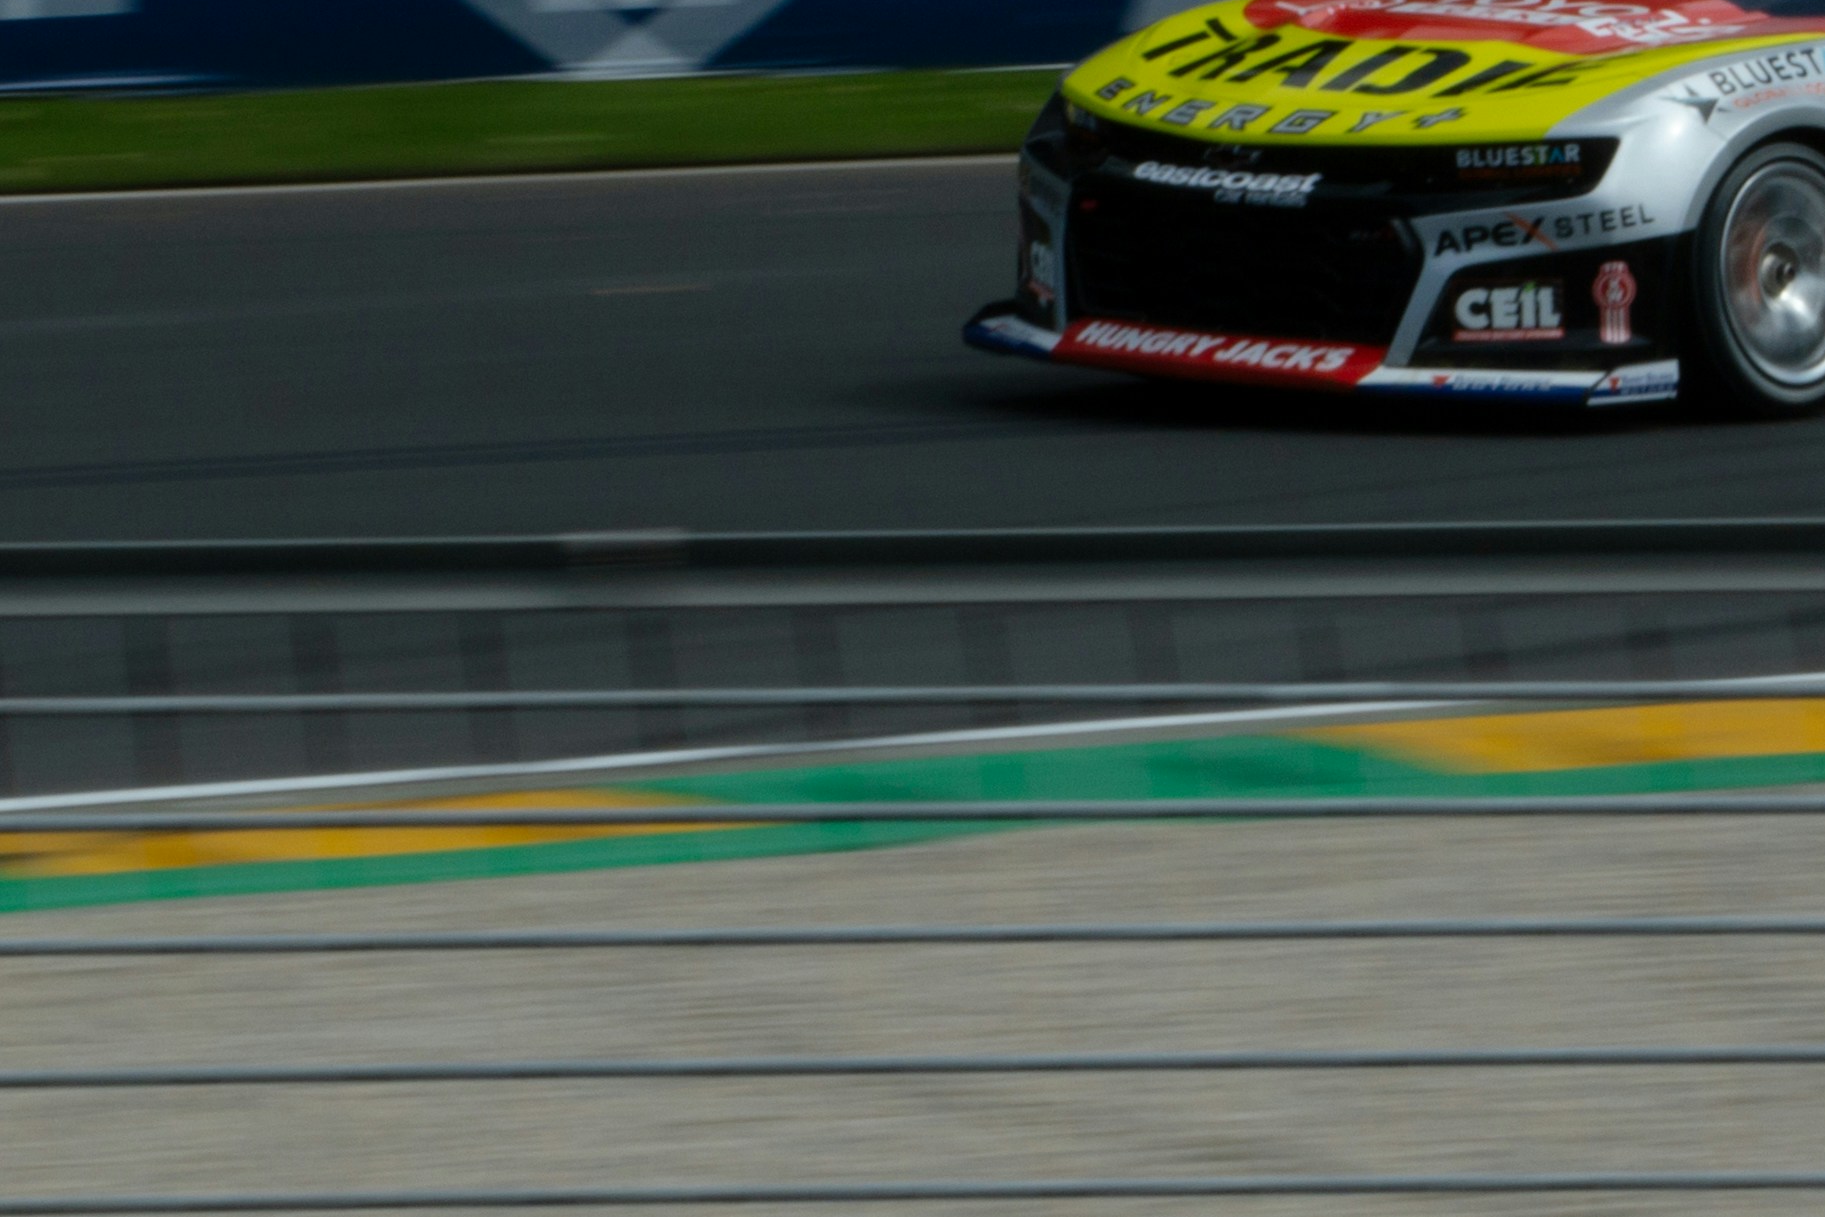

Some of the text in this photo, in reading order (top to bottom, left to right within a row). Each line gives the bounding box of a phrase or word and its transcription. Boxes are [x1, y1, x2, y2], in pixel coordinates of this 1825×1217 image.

[1456, 143, 1581, 169] BLUESTAR
[1133, 160, 1325, 193] eastcoast
[1555, 204, 1655, 239] STEEL
[1455, 282, 1562, 330] CEIL
[1075, 320, 1221, 360] HUNGRY
